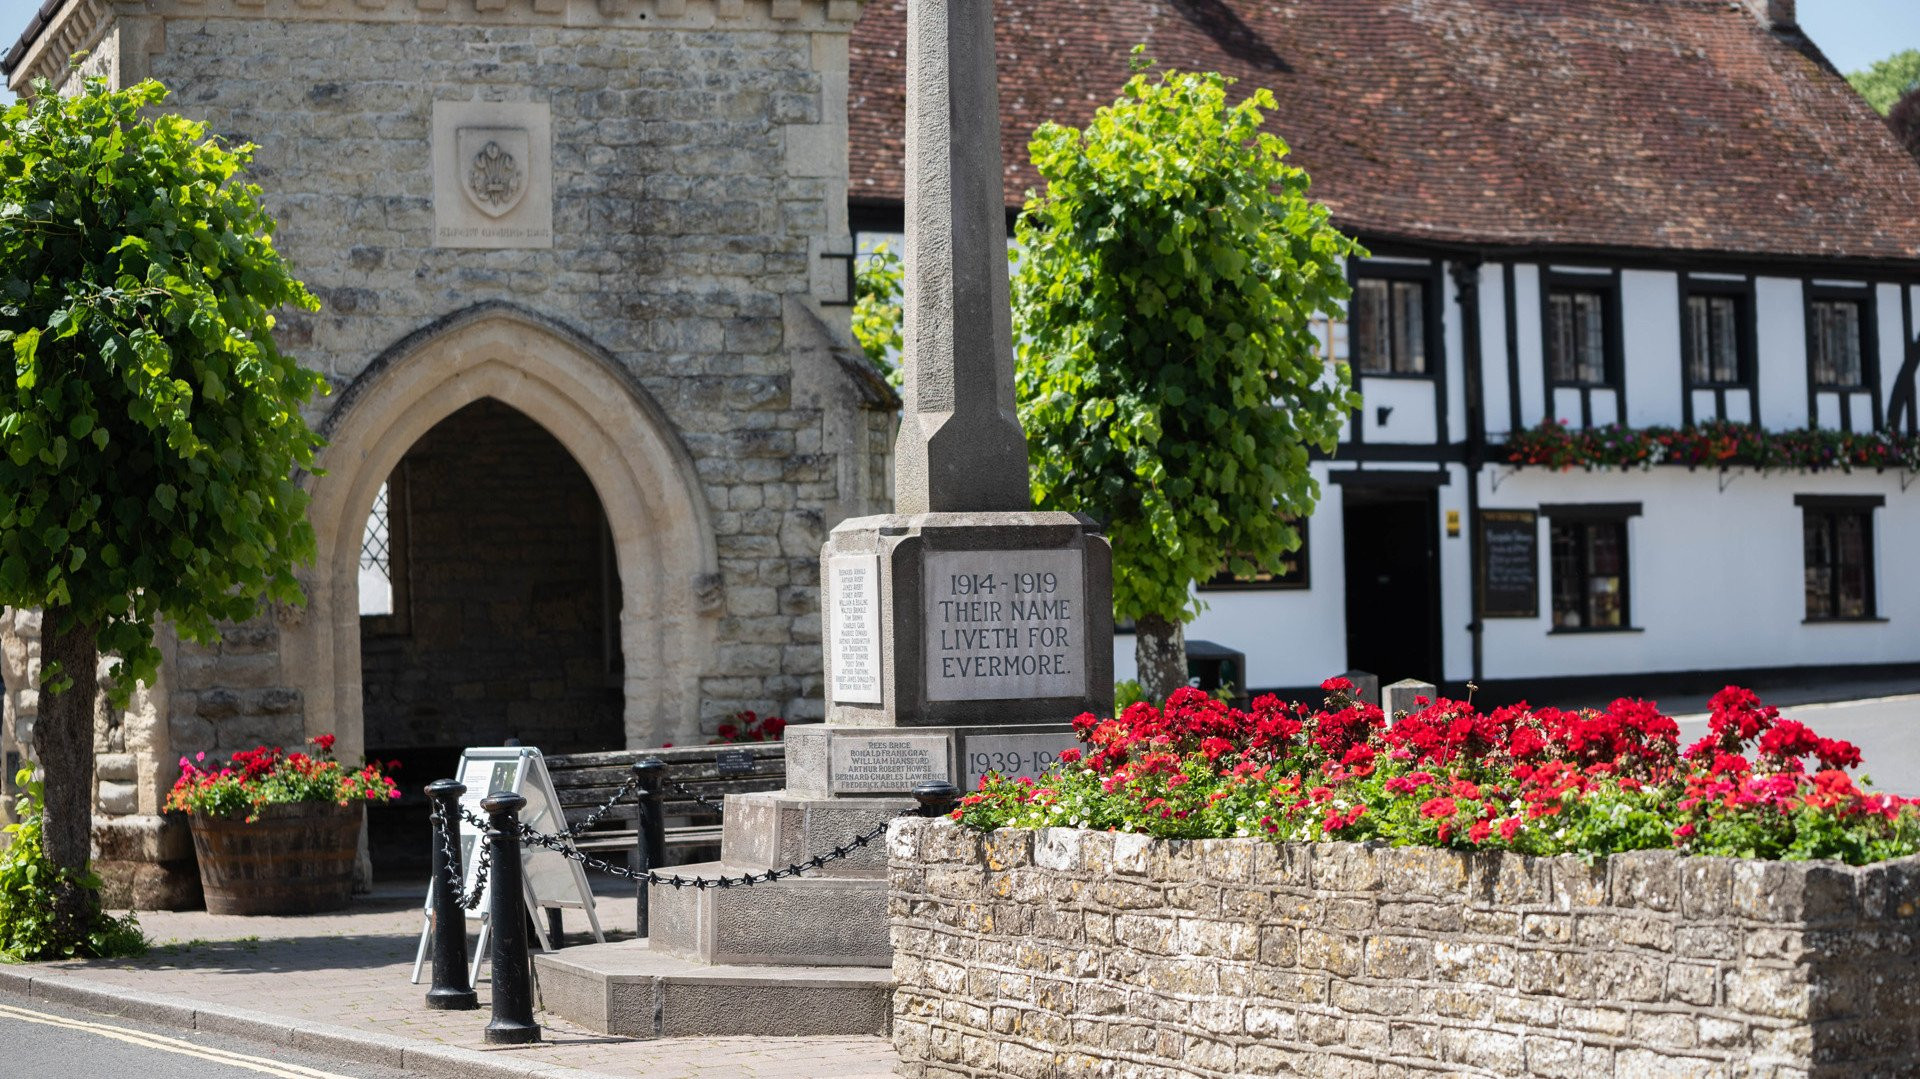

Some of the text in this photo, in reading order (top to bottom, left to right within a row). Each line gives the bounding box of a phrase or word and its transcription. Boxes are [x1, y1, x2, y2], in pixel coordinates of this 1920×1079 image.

[939, 600, 1070, 622] THEIR NAME
[942, 627, 1070, 650] LIVETH FOR
[942, 654, 1071, 678] EVERMORE.
